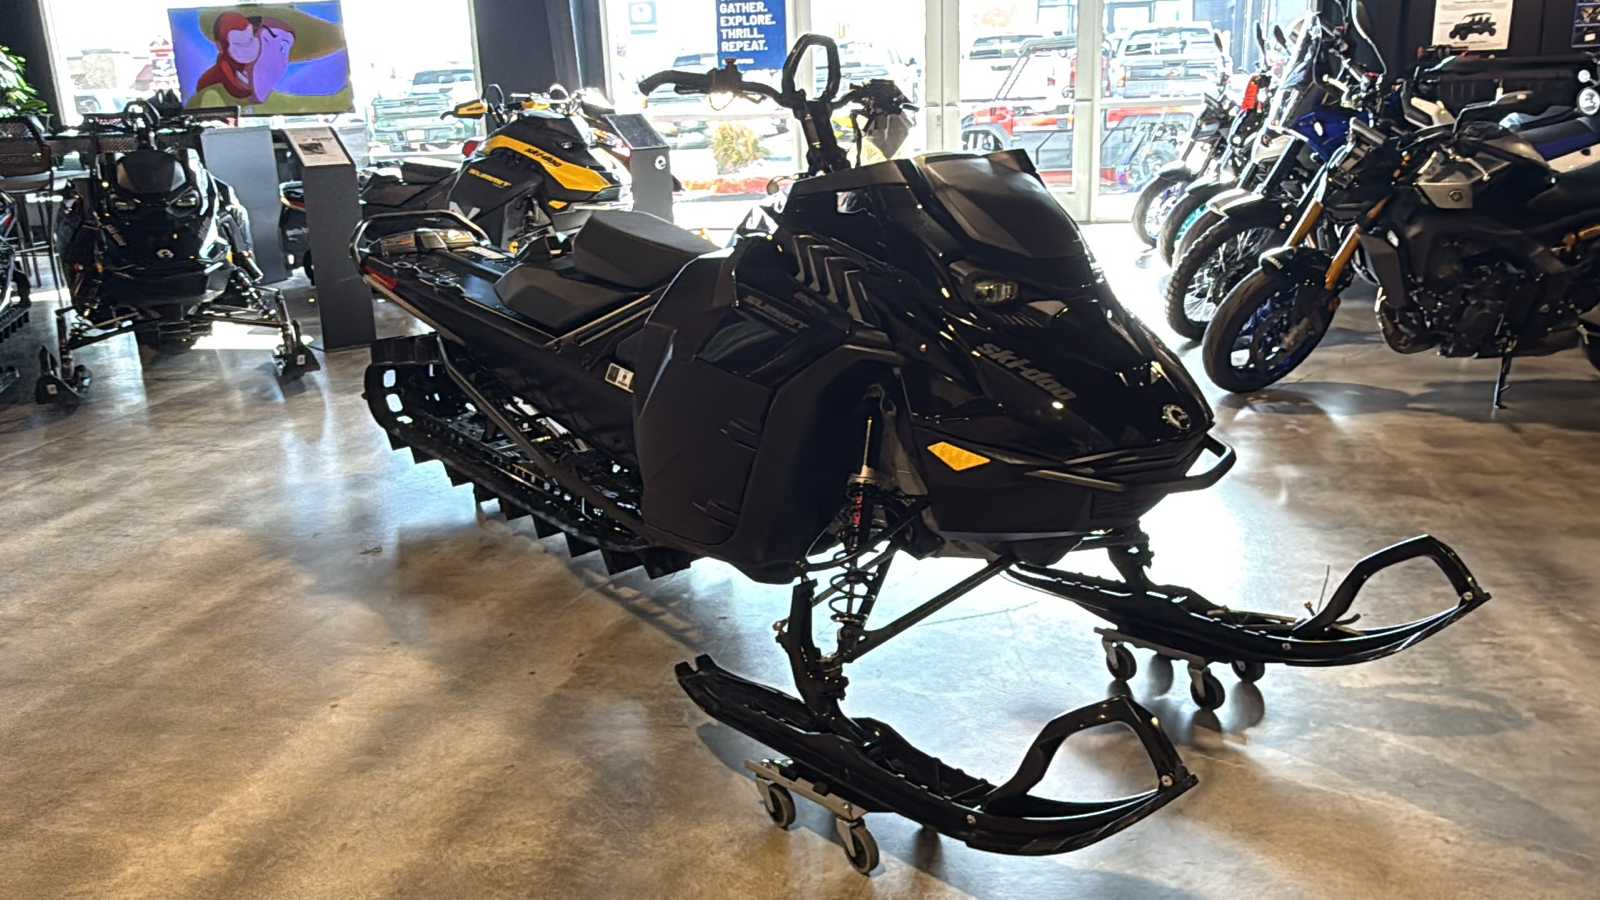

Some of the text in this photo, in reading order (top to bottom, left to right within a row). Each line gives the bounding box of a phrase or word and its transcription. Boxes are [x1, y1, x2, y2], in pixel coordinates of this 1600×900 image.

[719, 1, 768, 14] GATHER.
[720, 14, 776, 26] EXPLORE.
[720, 27, 765, 39] THRILL.
[721, 39, 768, 52] REPEAT.
